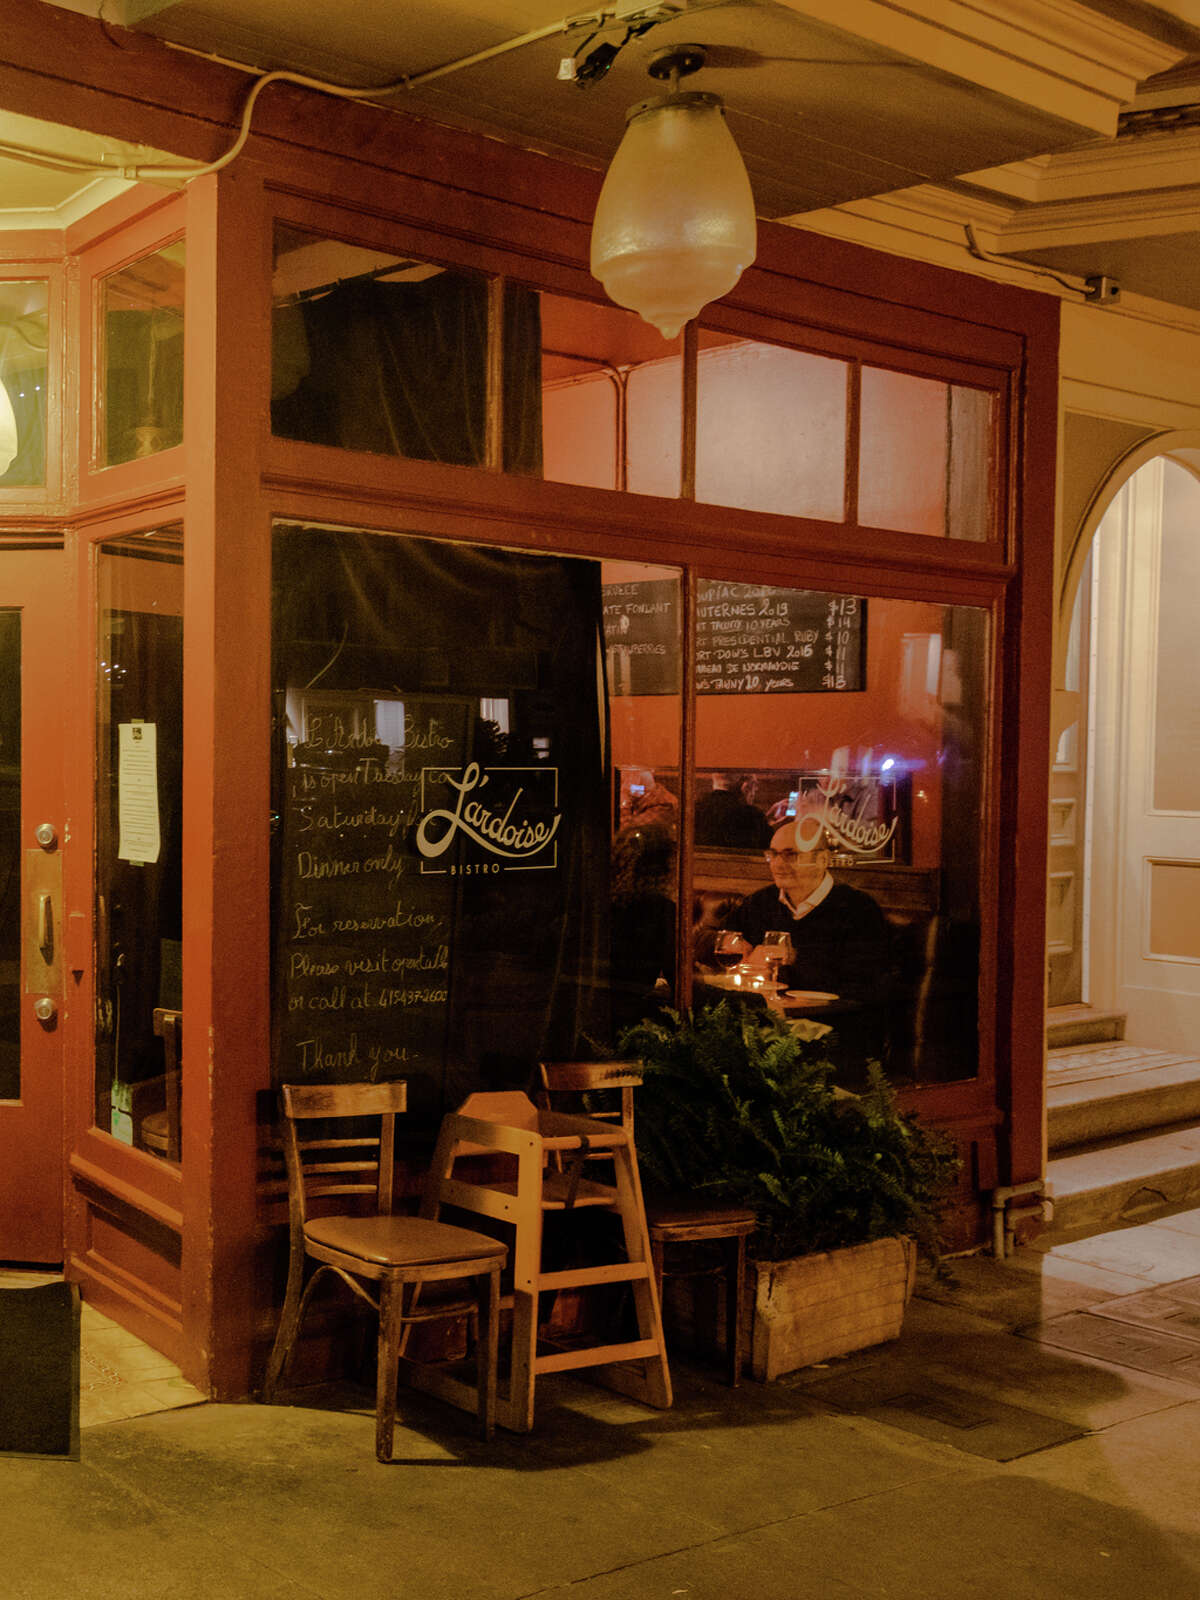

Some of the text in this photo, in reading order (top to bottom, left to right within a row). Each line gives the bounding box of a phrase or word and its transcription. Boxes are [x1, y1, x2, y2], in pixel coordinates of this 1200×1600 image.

[416, 761, 562, 858] L'ardoise
[296, 844, 405, 891] Dinner only
[450, 863, 500, 876] BISTRO
[292, 902, 326, 940] For
[290, 952, 341, 980] Please
[344, 947, 391, 976] visit
[309, 985, 347, 1009] call
[351, 981, 371, 1009] at
[295, 1031, 361, 1073] Thank
